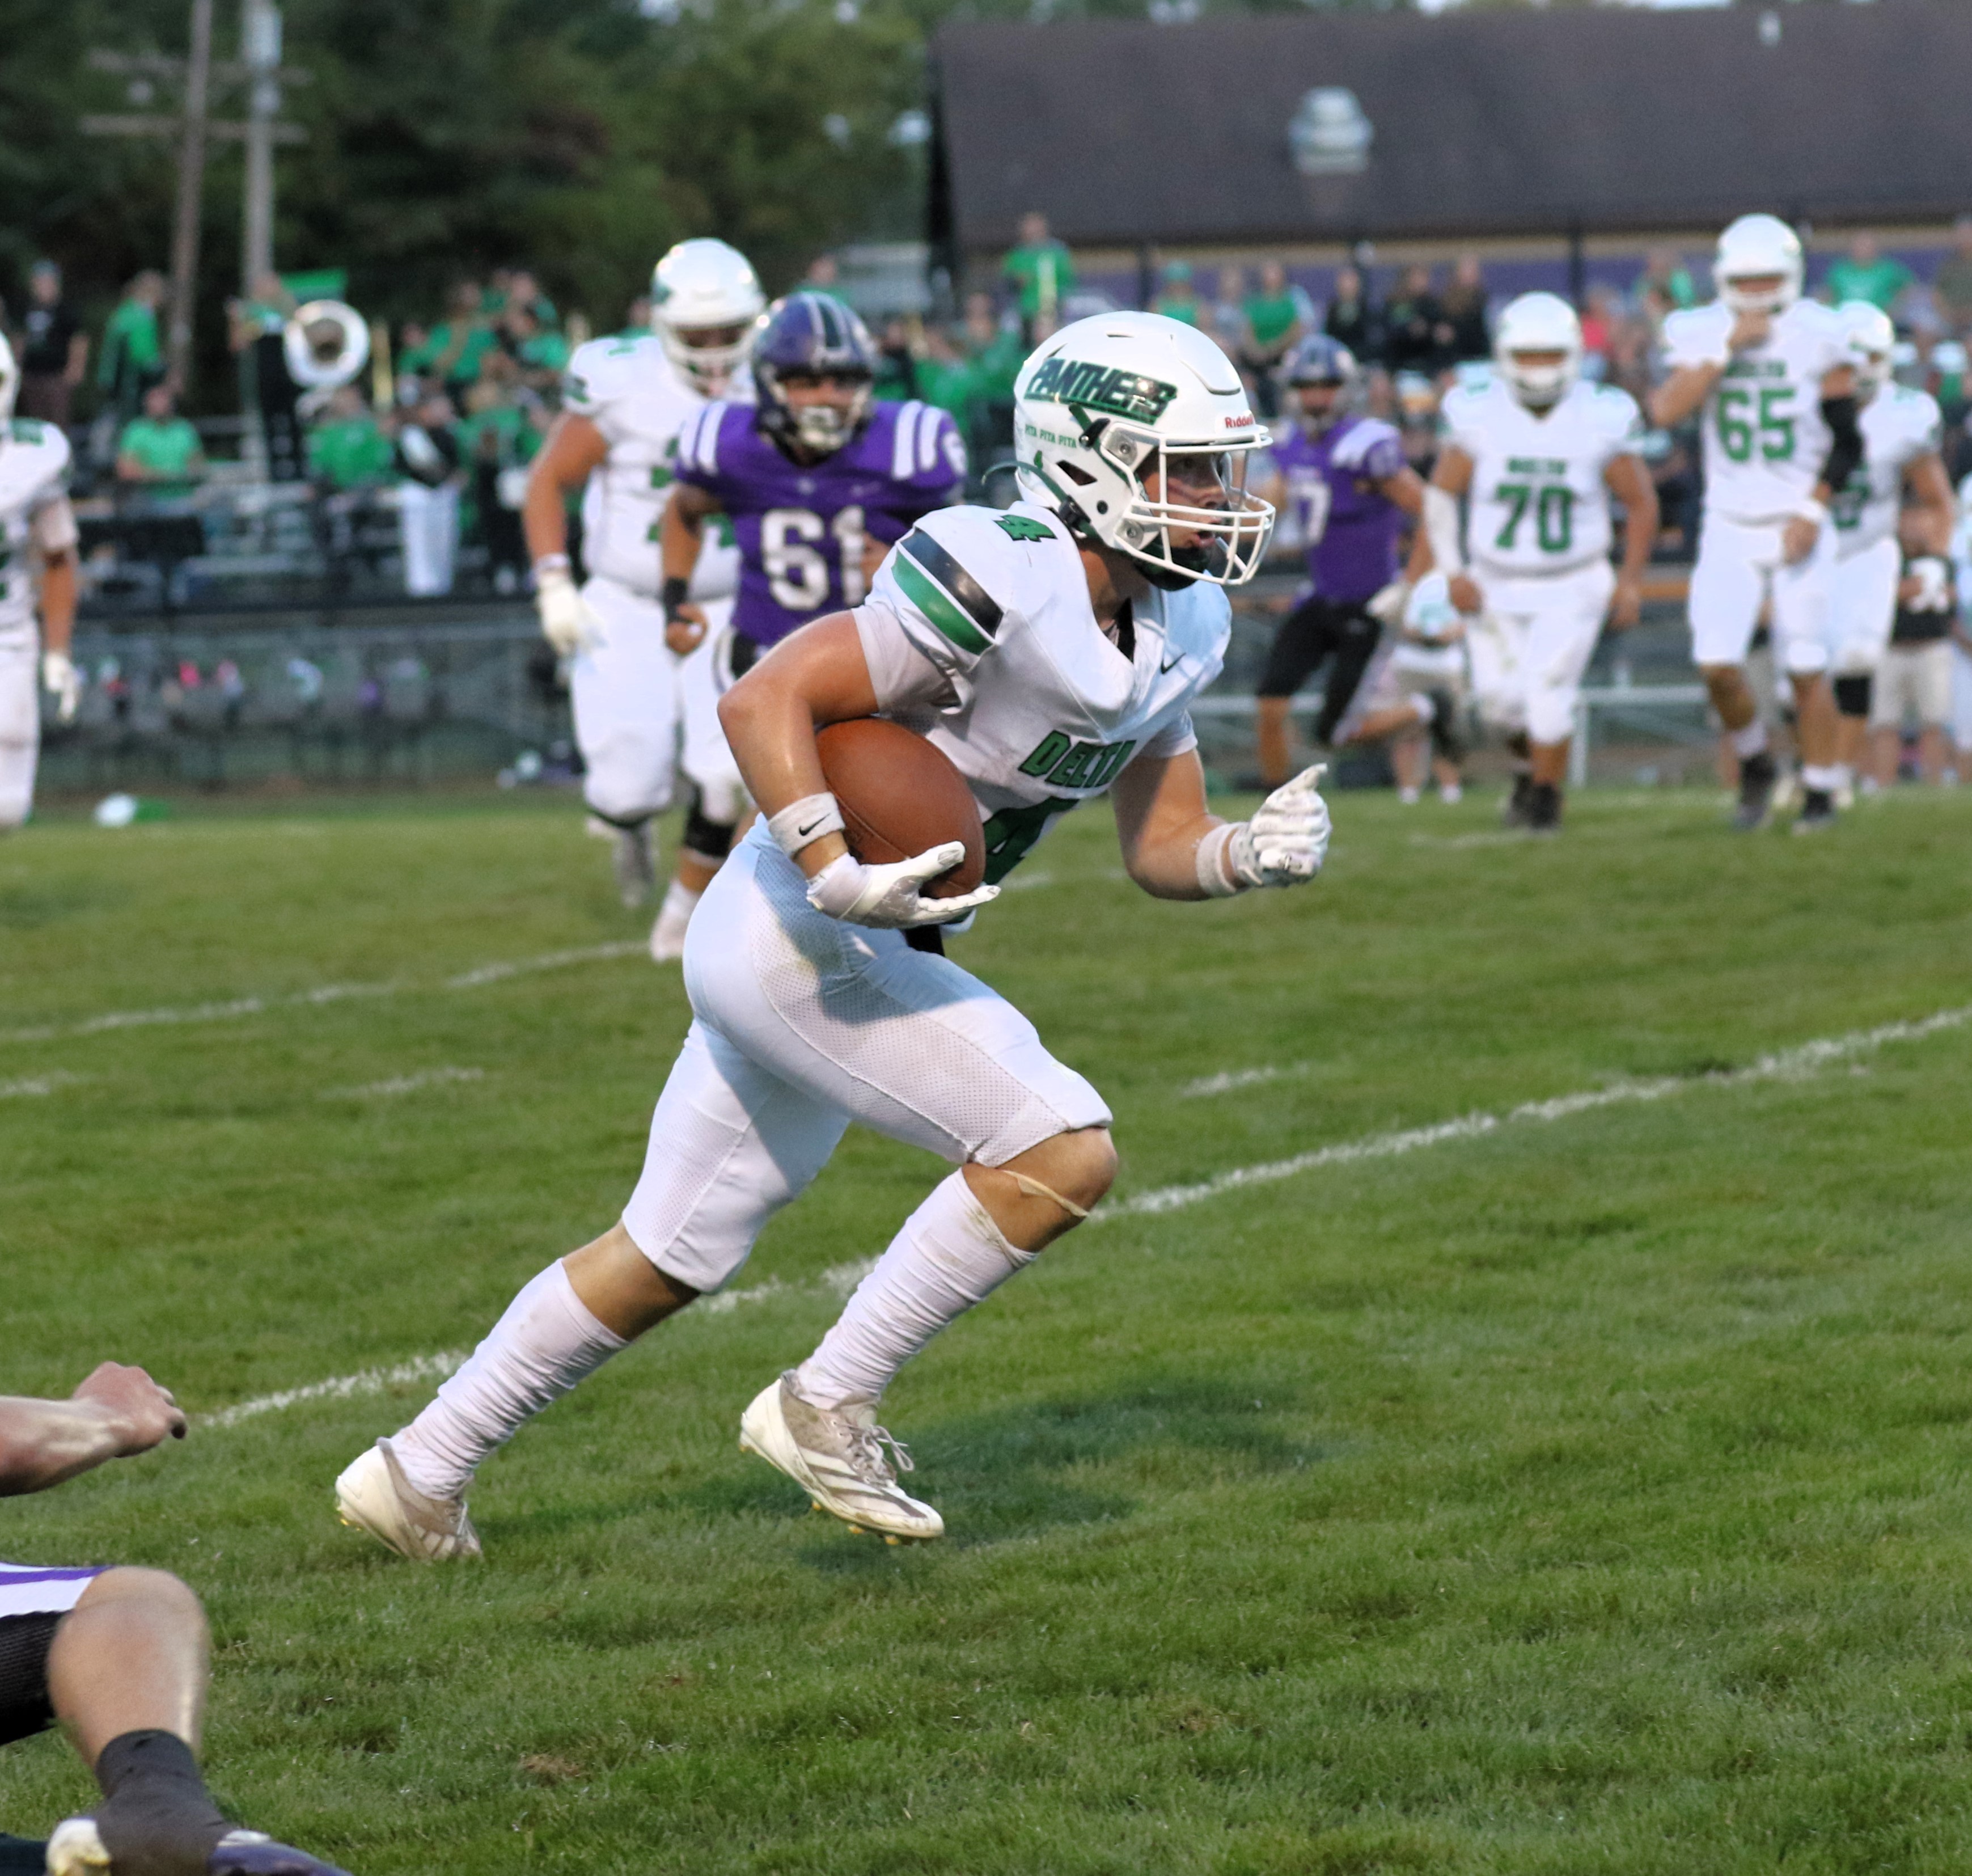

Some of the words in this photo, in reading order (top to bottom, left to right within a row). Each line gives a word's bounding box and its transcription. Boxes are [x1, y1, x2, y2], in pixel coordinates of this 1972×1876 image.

[1040, 429, 1055, 443] PITA
[1059, 435, 1077, 448] PITA
[1717, 388, 1795, 463] 65
[993, 514, 1058, 543] 4
[1495, 484, 1574, 551] 70
[761, 505, 865, 611] 61
